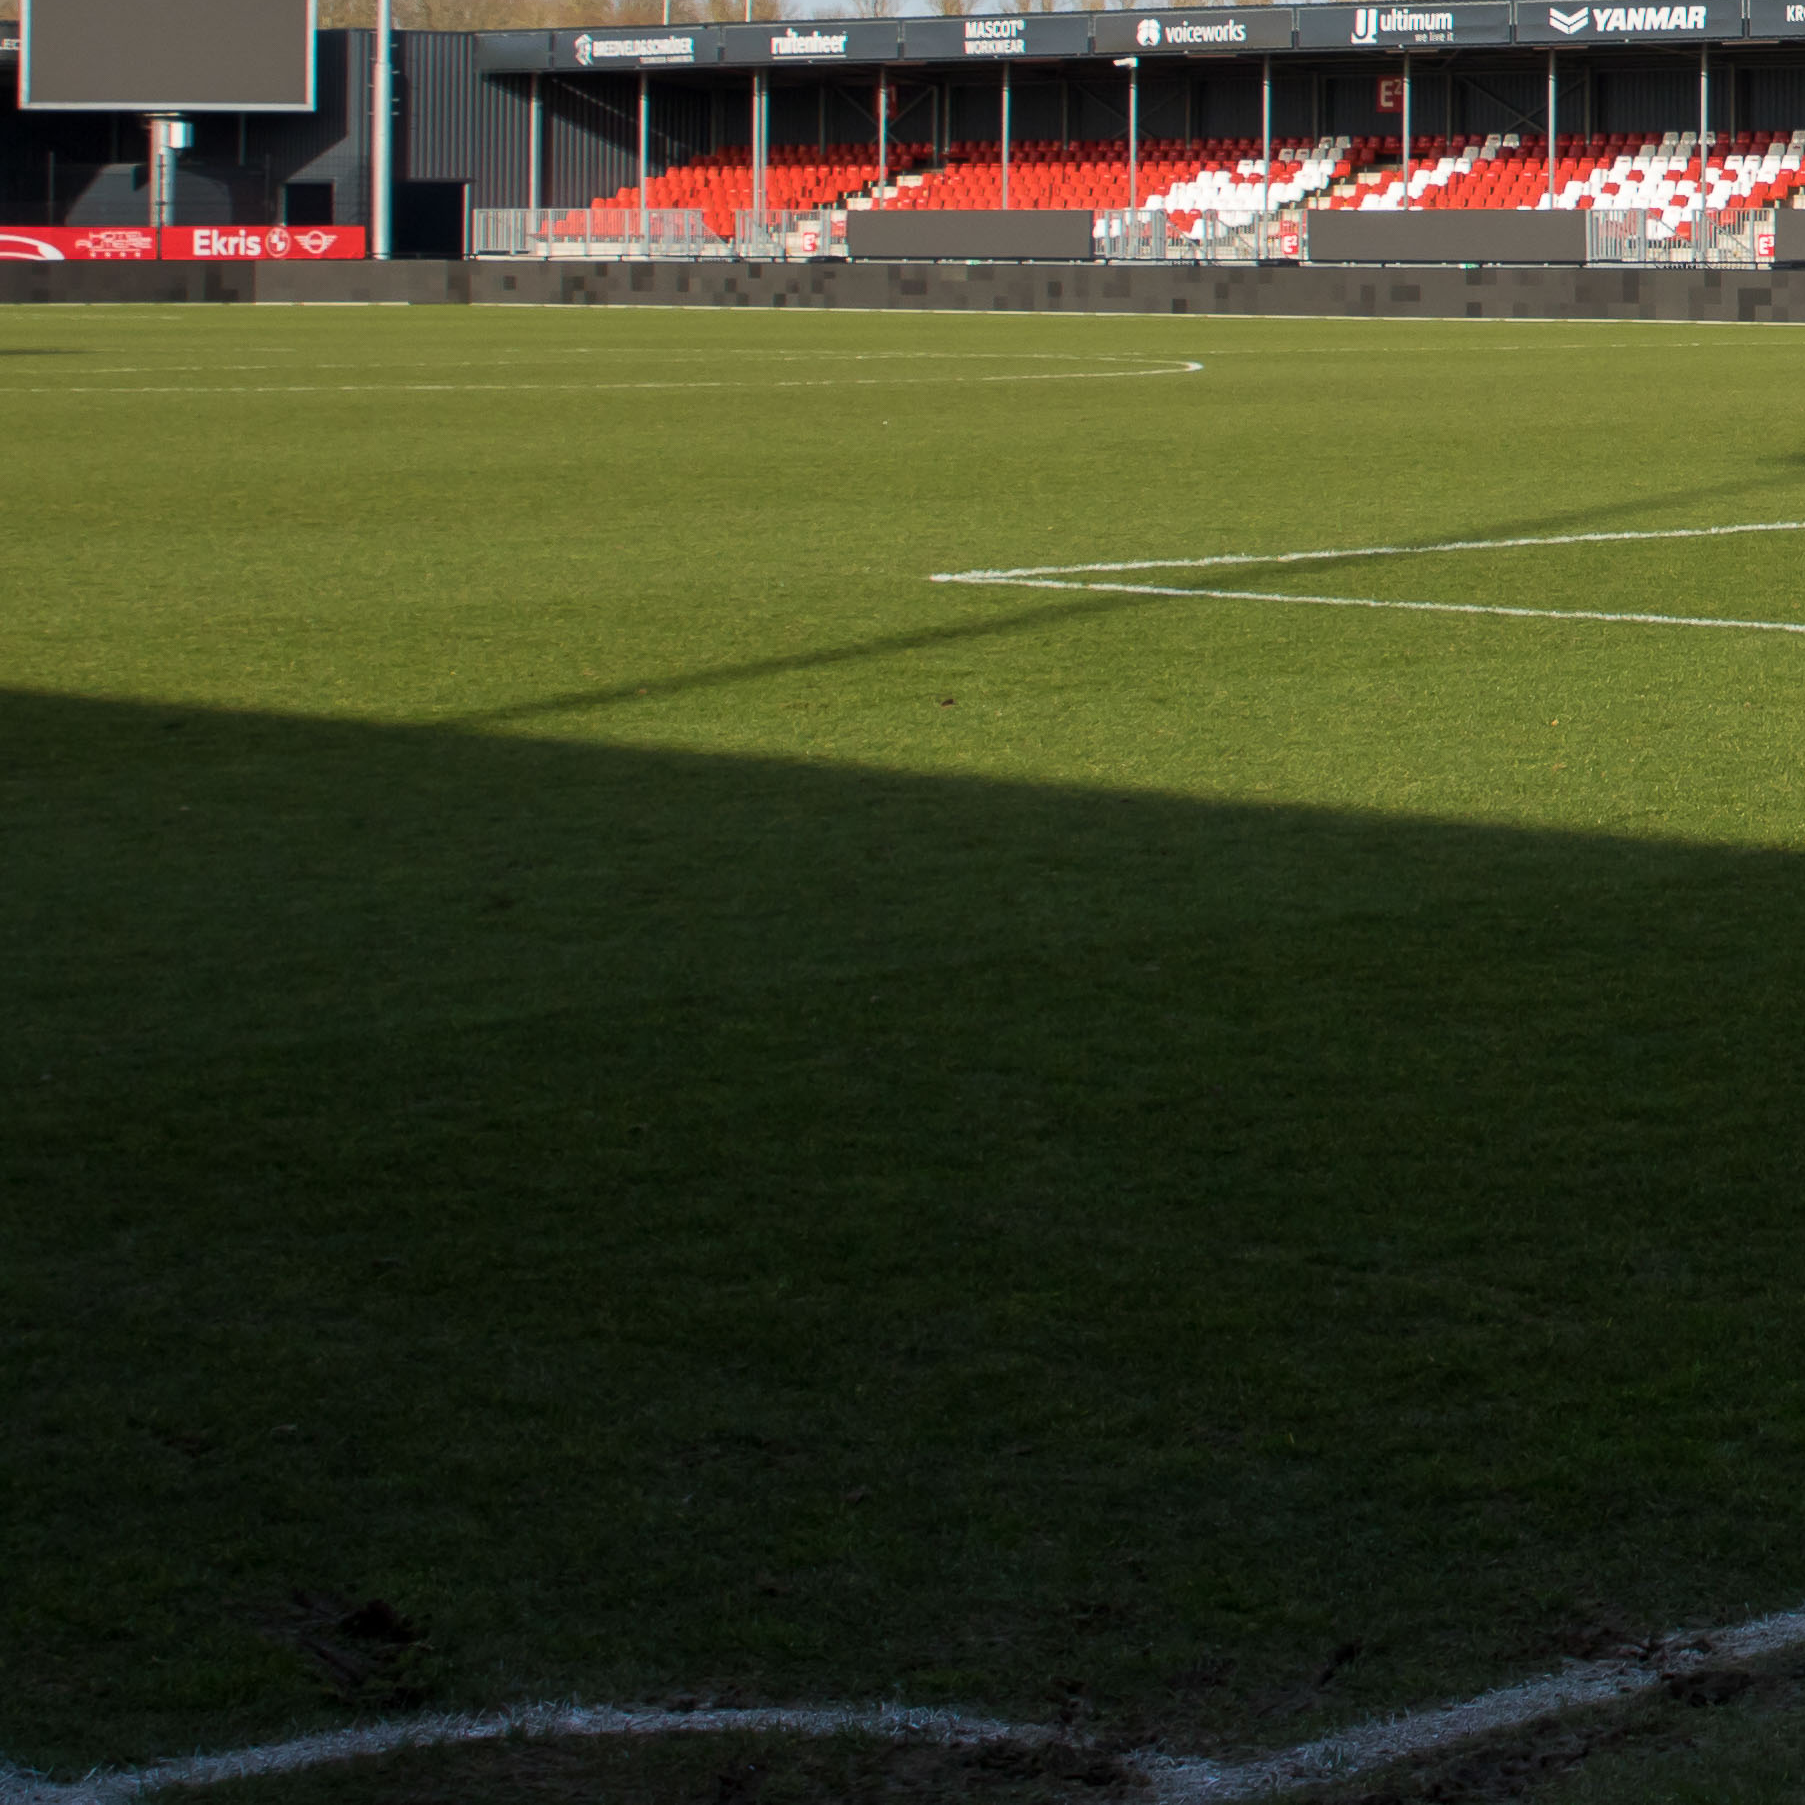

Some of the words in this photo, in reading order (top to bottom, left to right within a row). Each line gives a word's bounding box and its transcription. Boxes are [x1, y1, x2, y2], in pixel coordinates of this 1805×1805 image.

[1165, 19, 1247, 43] voiceworks
[1380, 8, 1453, 32] ultimum
[1592, 6, 1707, 32] YANMAR
[964, 39, 1025, 55] WORKWEAR
[193, 228, 261, 256] Ekris
